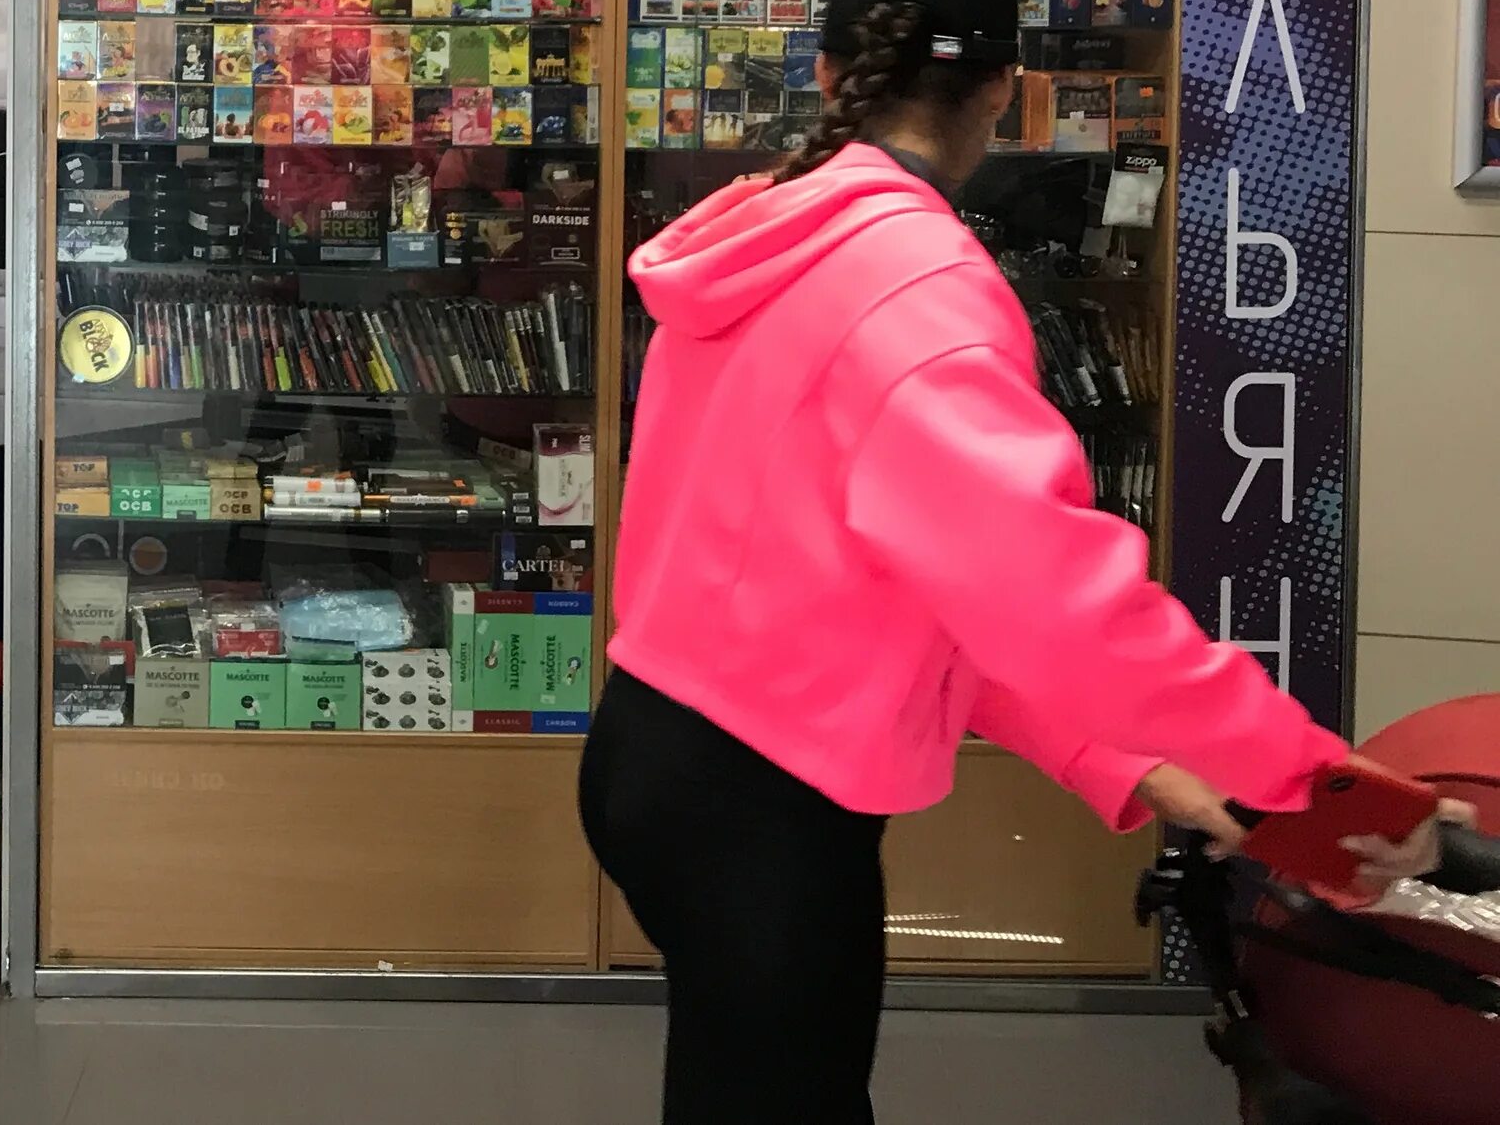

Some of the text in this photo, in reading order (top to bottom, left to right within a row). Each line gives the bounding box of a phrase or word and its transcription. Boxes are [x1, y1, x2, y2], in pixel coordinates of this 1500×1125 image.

[532, 214, 590, 226] DARKSIDE
[320, 220, 379, 238] FRESH
[73, 463, 95, 473] TOP
[57, 503, 78, 512] TOP
[120, 500, 152, 511] OCB
[219, 503, 252, 515] OCB
[502, 559, 572, 573] CARTEL
[62, 607, 115, 618] MASCOTTE
[510, 633, 520, 691] MASCOTTE
[546, 635, 556, 692] MASCOTTE
[146, 671, 201, 682] MASCOTTE
[226, 672, 269, 682] MASCOTTE
[302, 674, 346, 684] MASCOTTE
